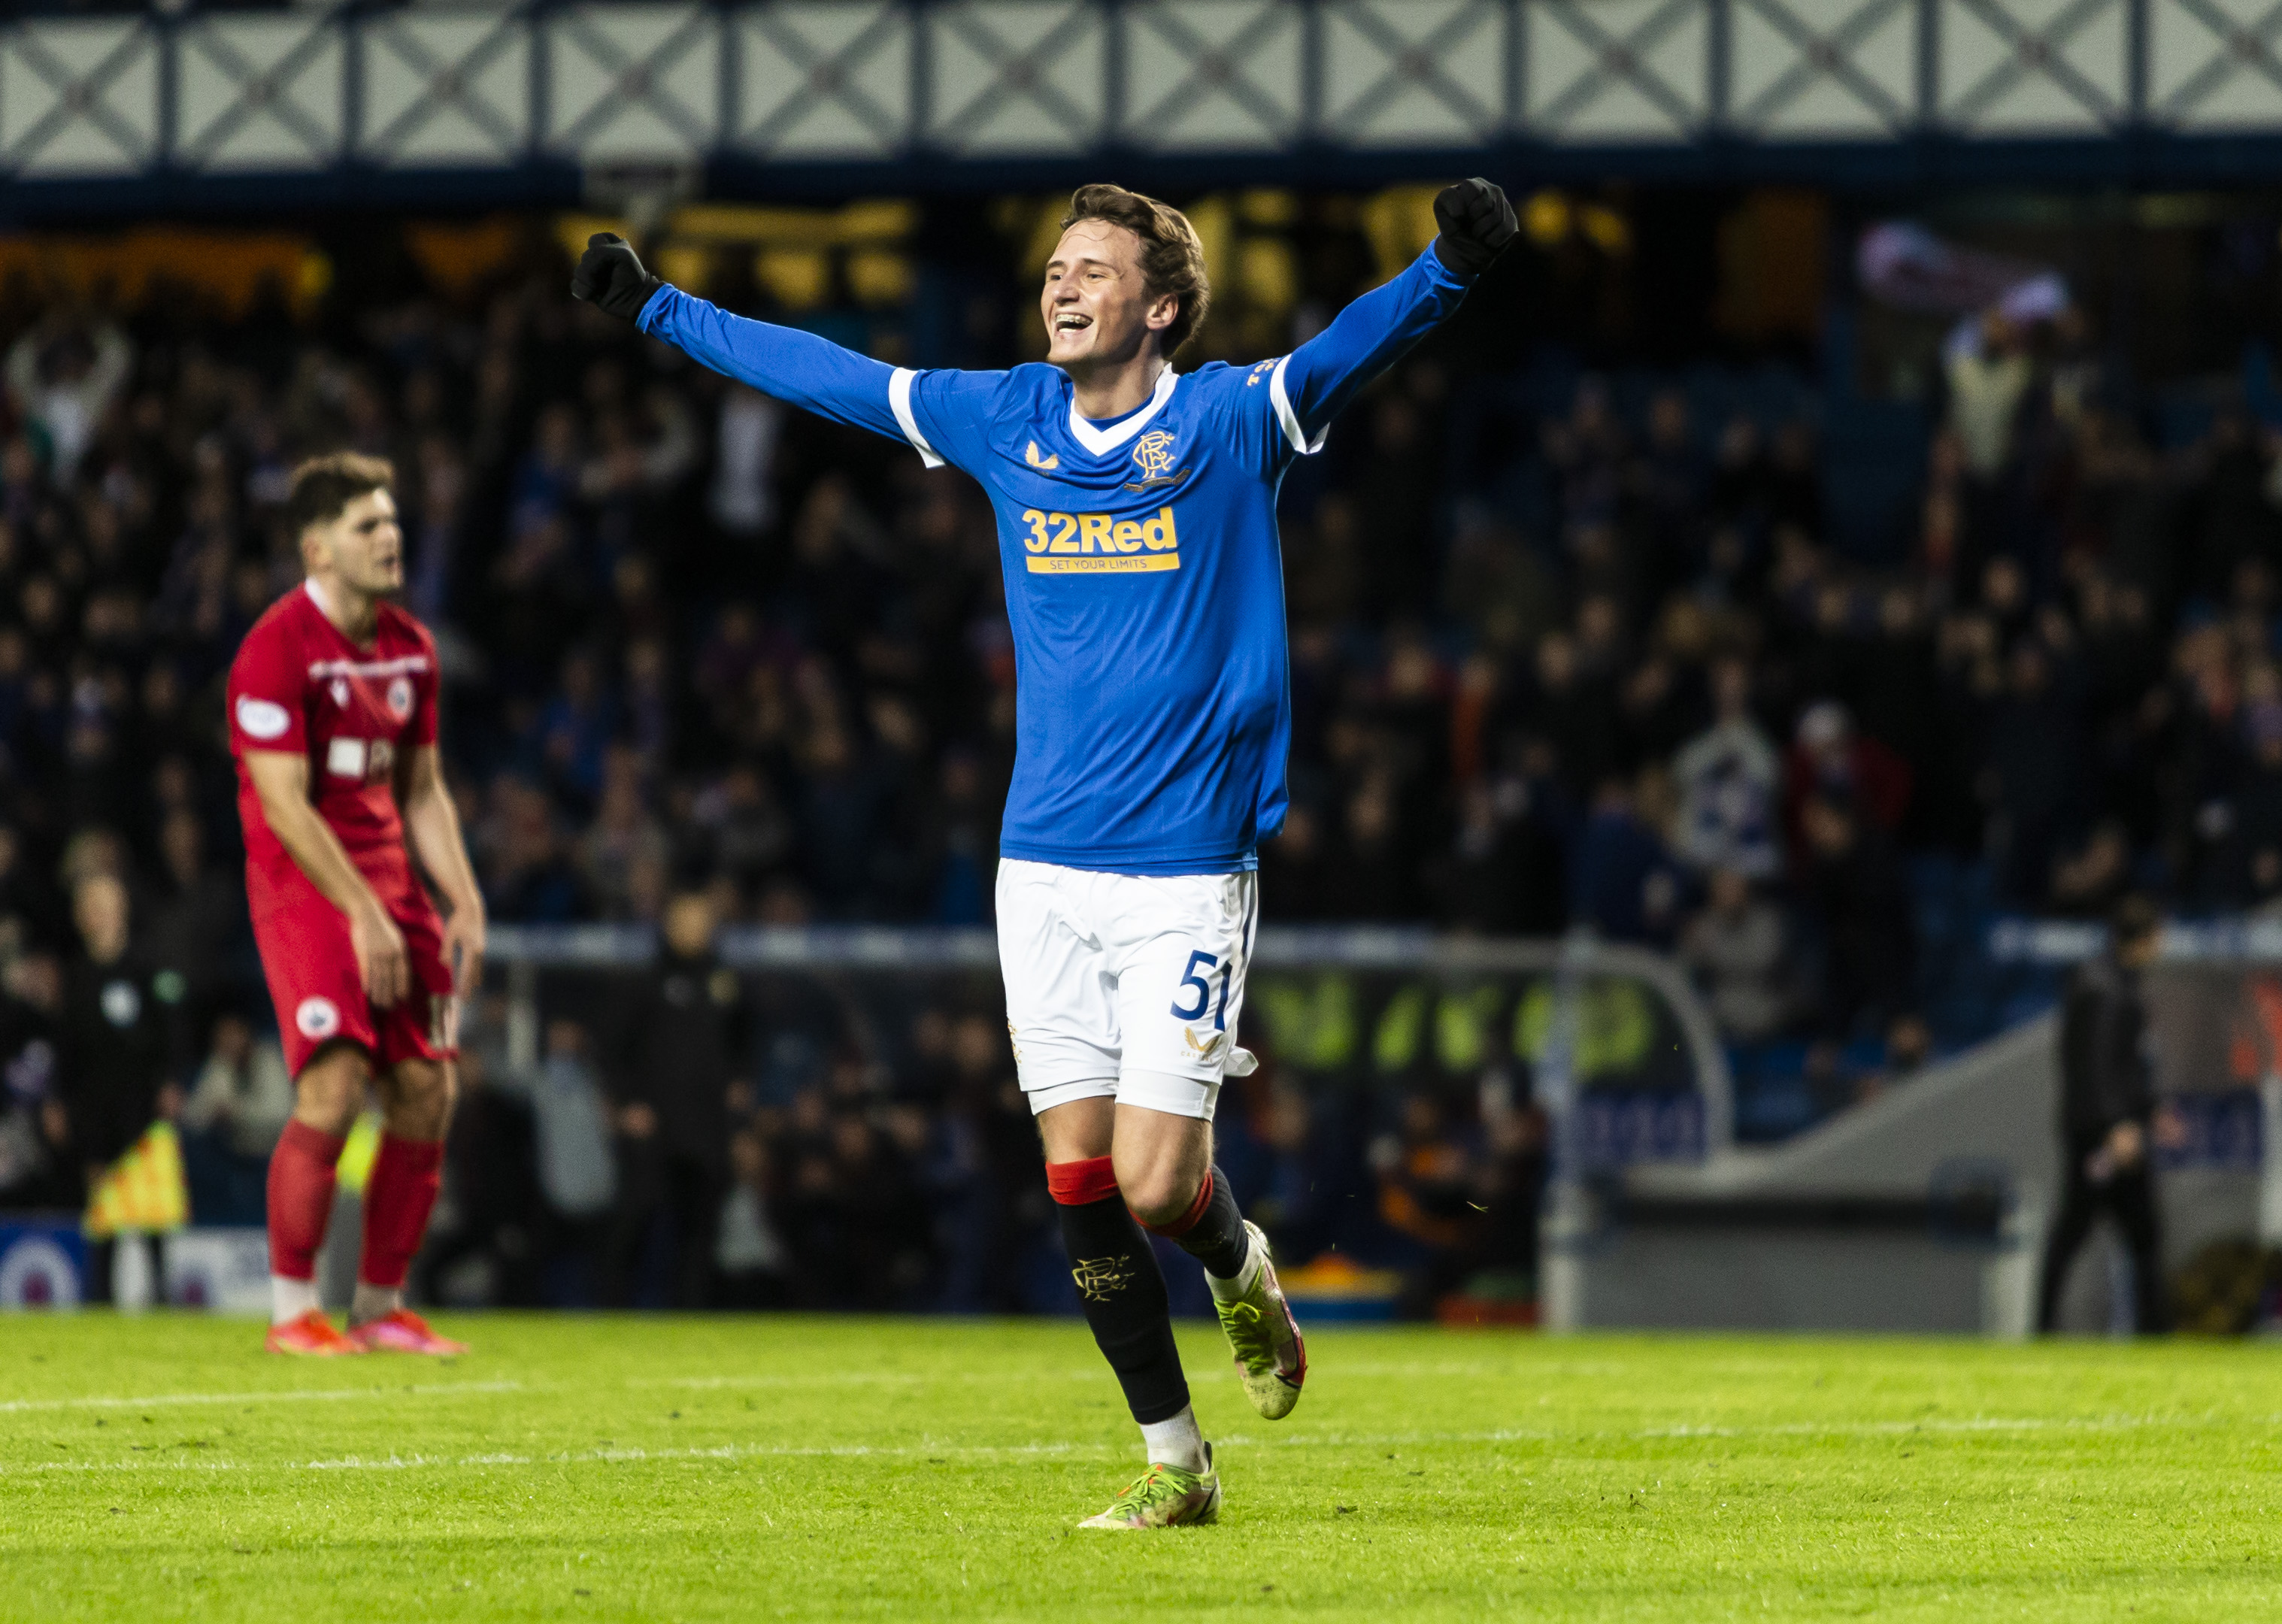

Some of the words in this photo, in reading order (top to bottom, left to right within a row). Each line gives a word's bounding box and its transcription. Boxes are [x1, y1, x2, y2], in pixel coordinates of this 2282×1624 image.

[1022, 506, 1177, 553] 32Red
[1050, 559, 1070, 570] SET
[1074, 559, 1105, 569] YOUR
[1109, 558, 1147, 569] LIMITS
[1170, 950, 1232, 1032] 51
